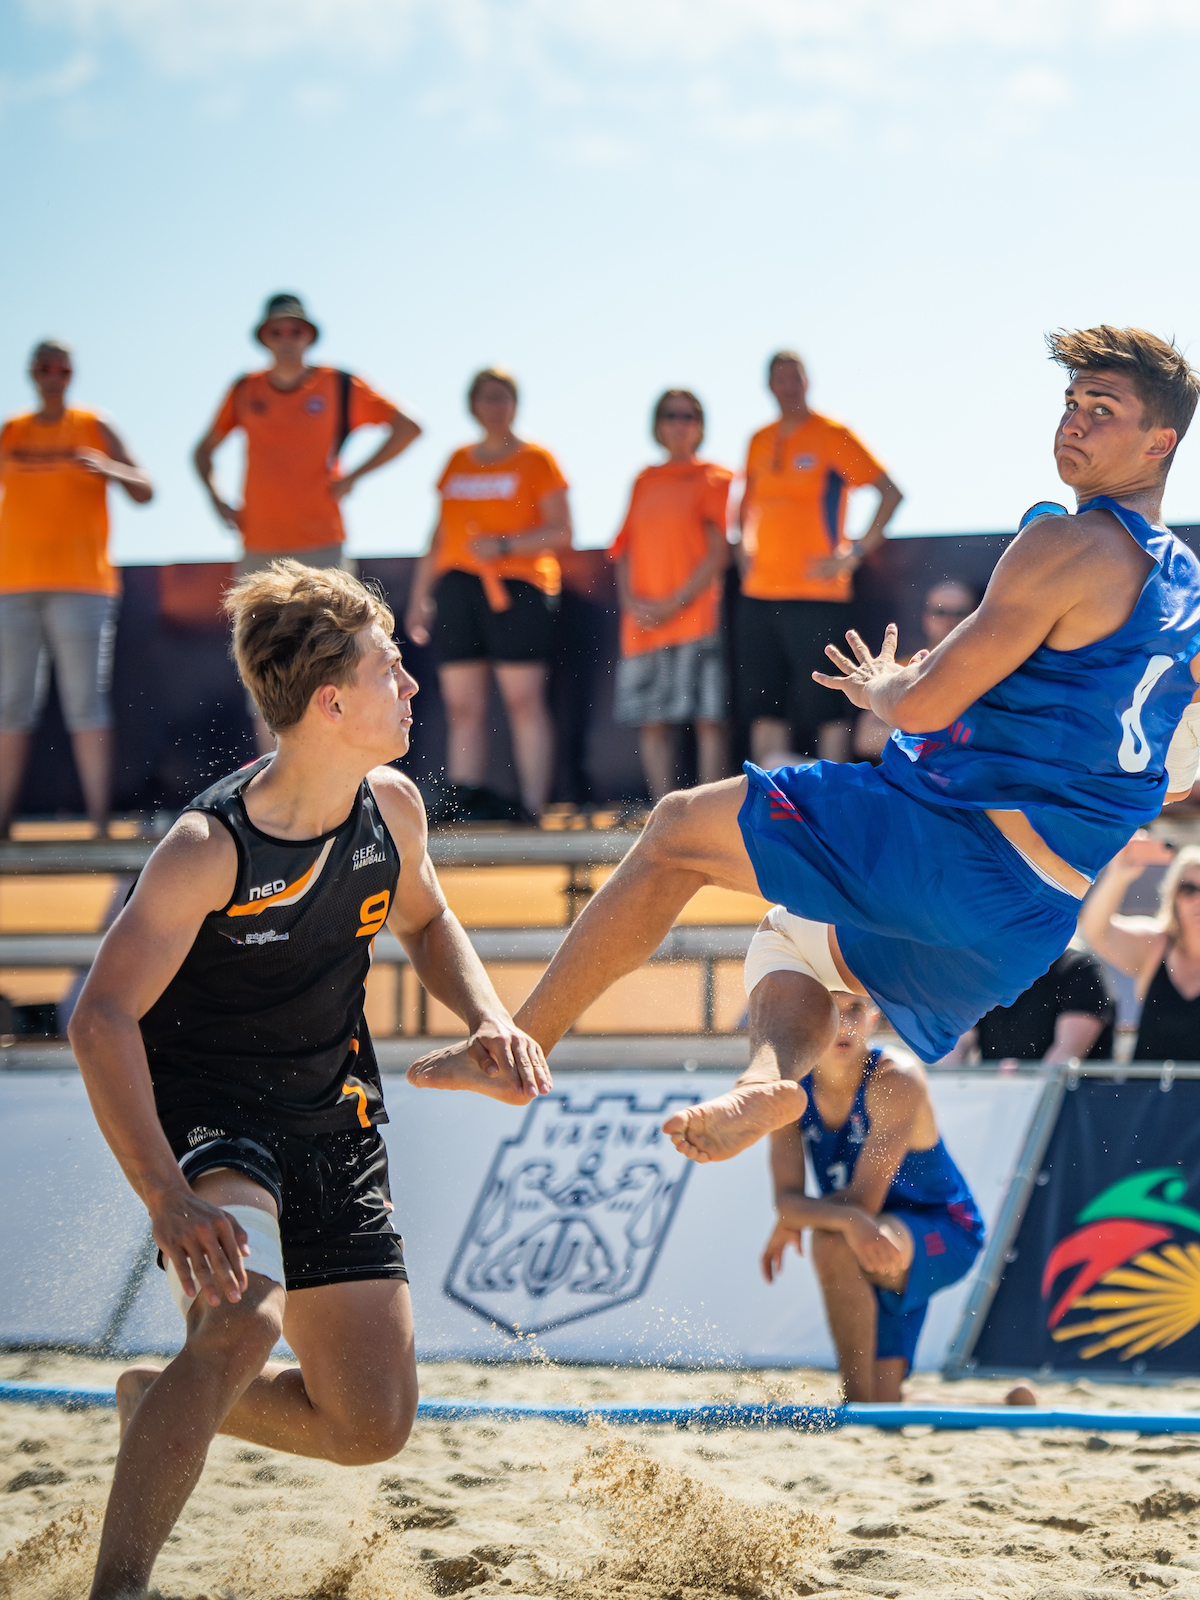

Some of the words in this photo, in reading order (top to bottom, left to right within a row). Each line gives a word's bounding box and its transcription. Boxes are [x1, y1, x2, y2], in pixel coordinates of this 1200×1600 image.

[1118, 654, 1175, 774] 6
[249, 878, 287, 901] NED
[355, 889, 391, 938] 9
[543, 1121, 662, 1150] VARNA
